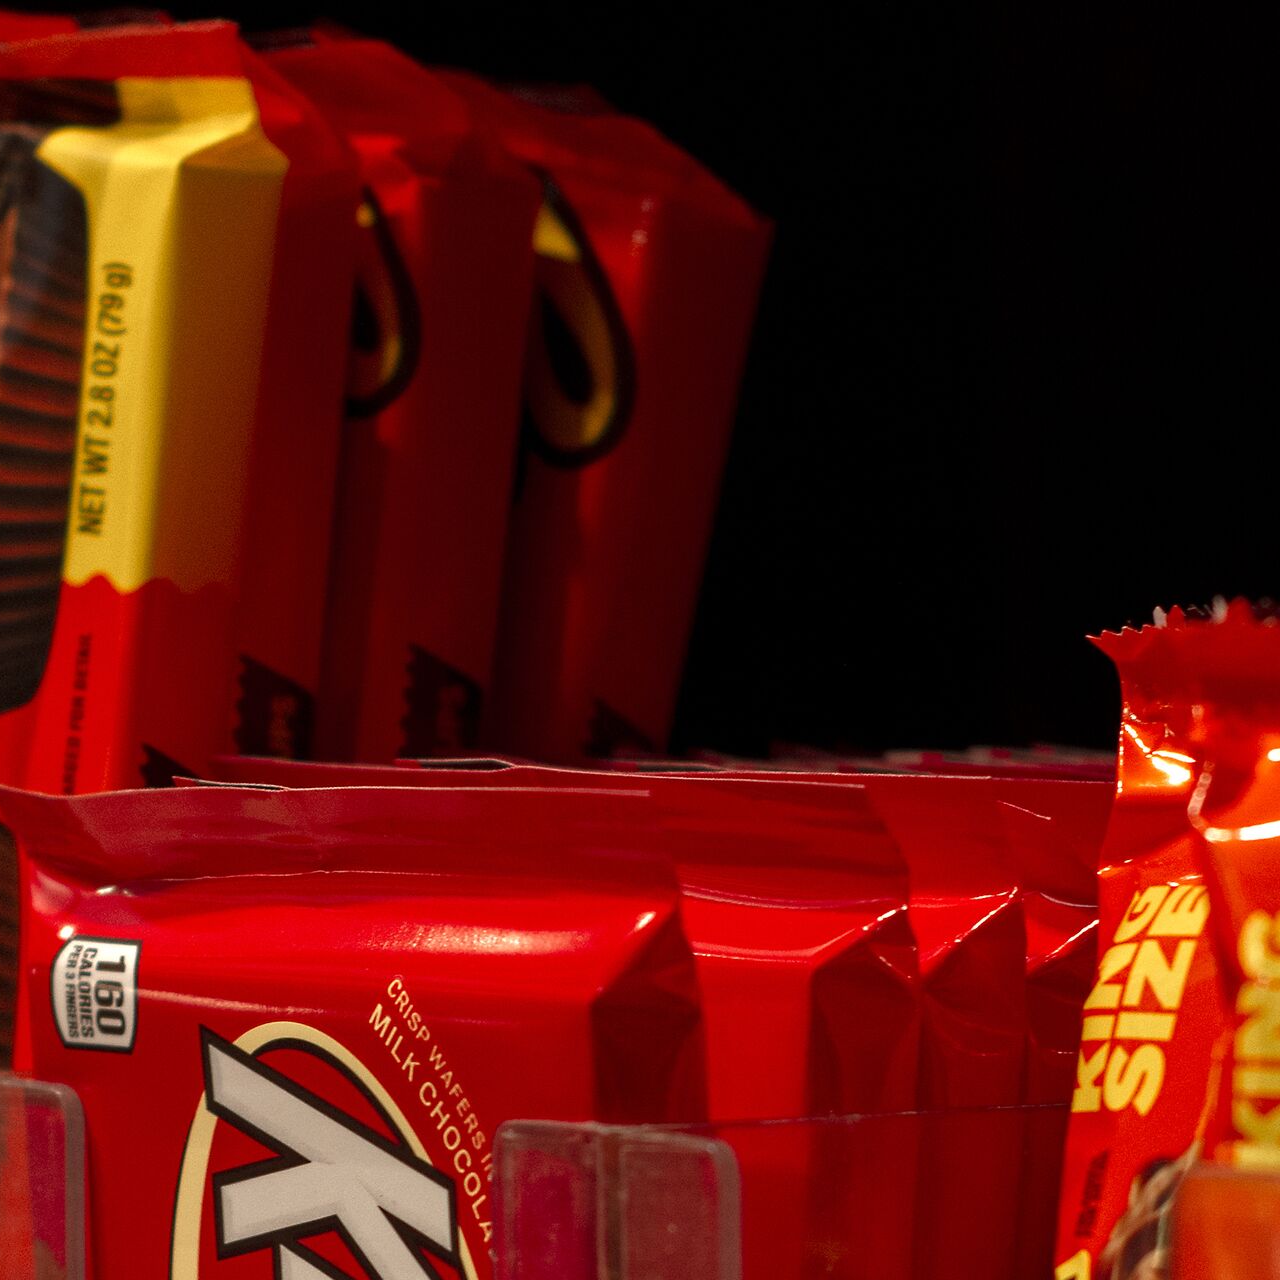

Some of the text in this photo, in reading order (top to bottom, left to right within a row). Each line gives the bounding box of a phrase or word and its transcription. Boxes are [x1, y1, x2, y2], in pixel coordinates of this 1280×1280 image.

[77, 262, 134, 535] NET WT 2.8 OZ (79 g)
[65, 945, 82, 1037] PER 3 FINGERS
[79, 948, 97, 1037] CALORIES
[94, 955, 126, 1036] 160
[387, 979, 431, 1042] CRISP
[428, 1045, 486, 1150] WAFERS
[1071, 885, 1159, 1113] KING
[1104, 885, 1211, 1116] SIZE
[369, 1003, 493, 1243] MILK CHOCOLA
